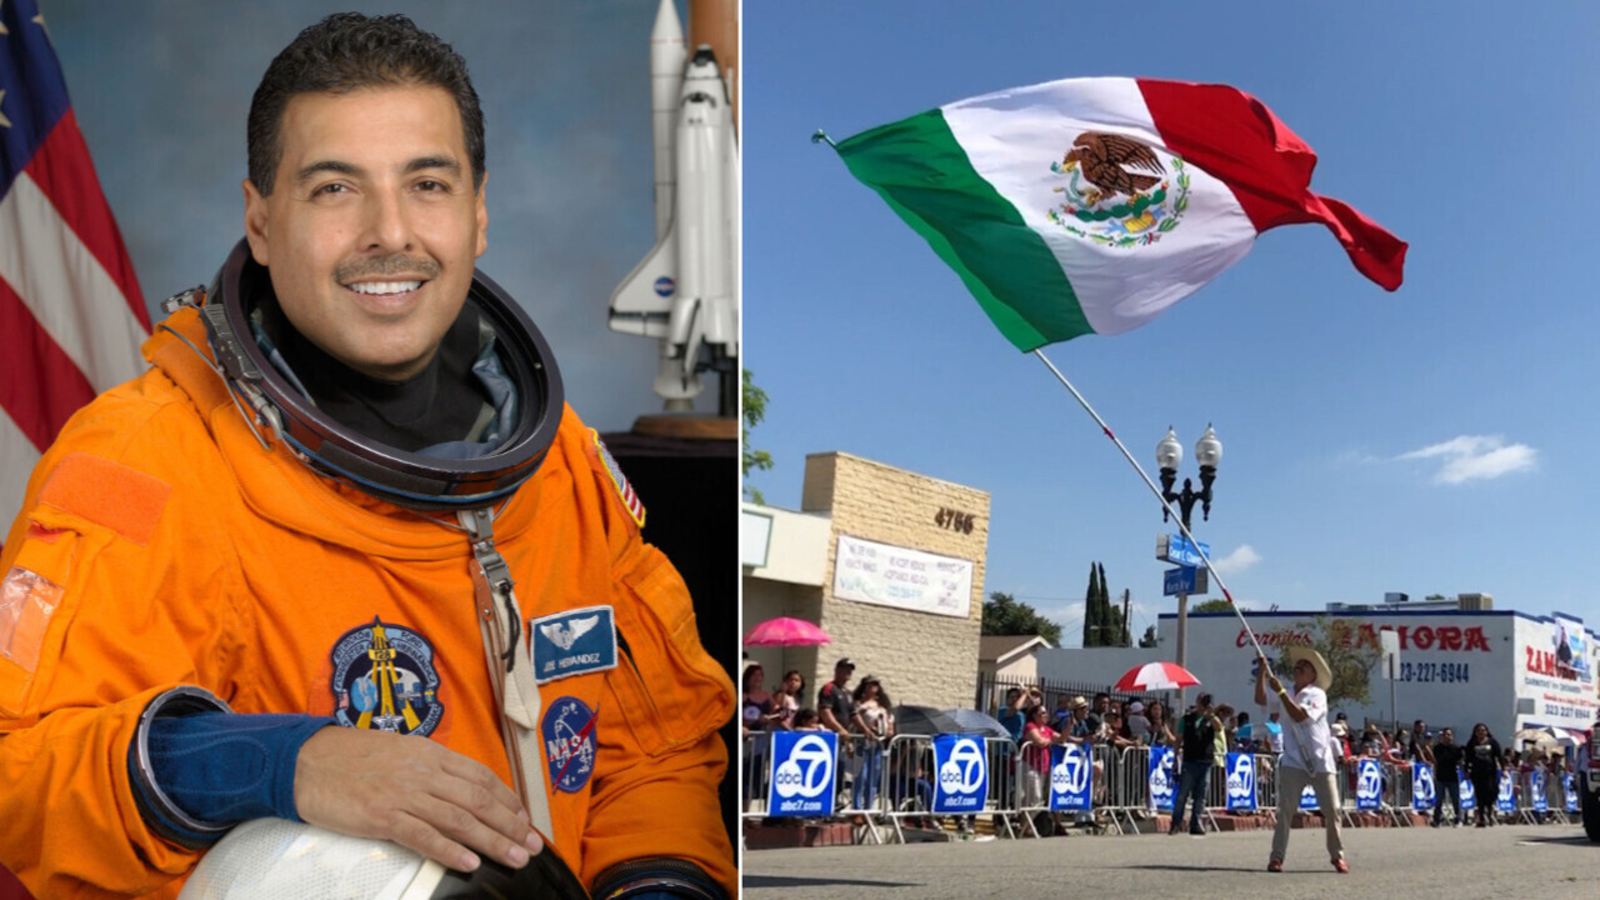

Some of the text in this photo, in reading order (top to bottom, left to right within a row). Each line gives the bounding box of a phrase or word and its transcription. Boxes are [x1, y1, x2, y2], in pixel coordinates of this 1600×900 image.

[1400, 662, 1470, 683] 23-227-6944
[547, 735, 593, 762] NASA
[776, 769, 801, 785] abc
[941, 769, 960, 783] abc
[1053, 770, 1070, 783] abc
[780, 799, 822, 811] abc7.com
